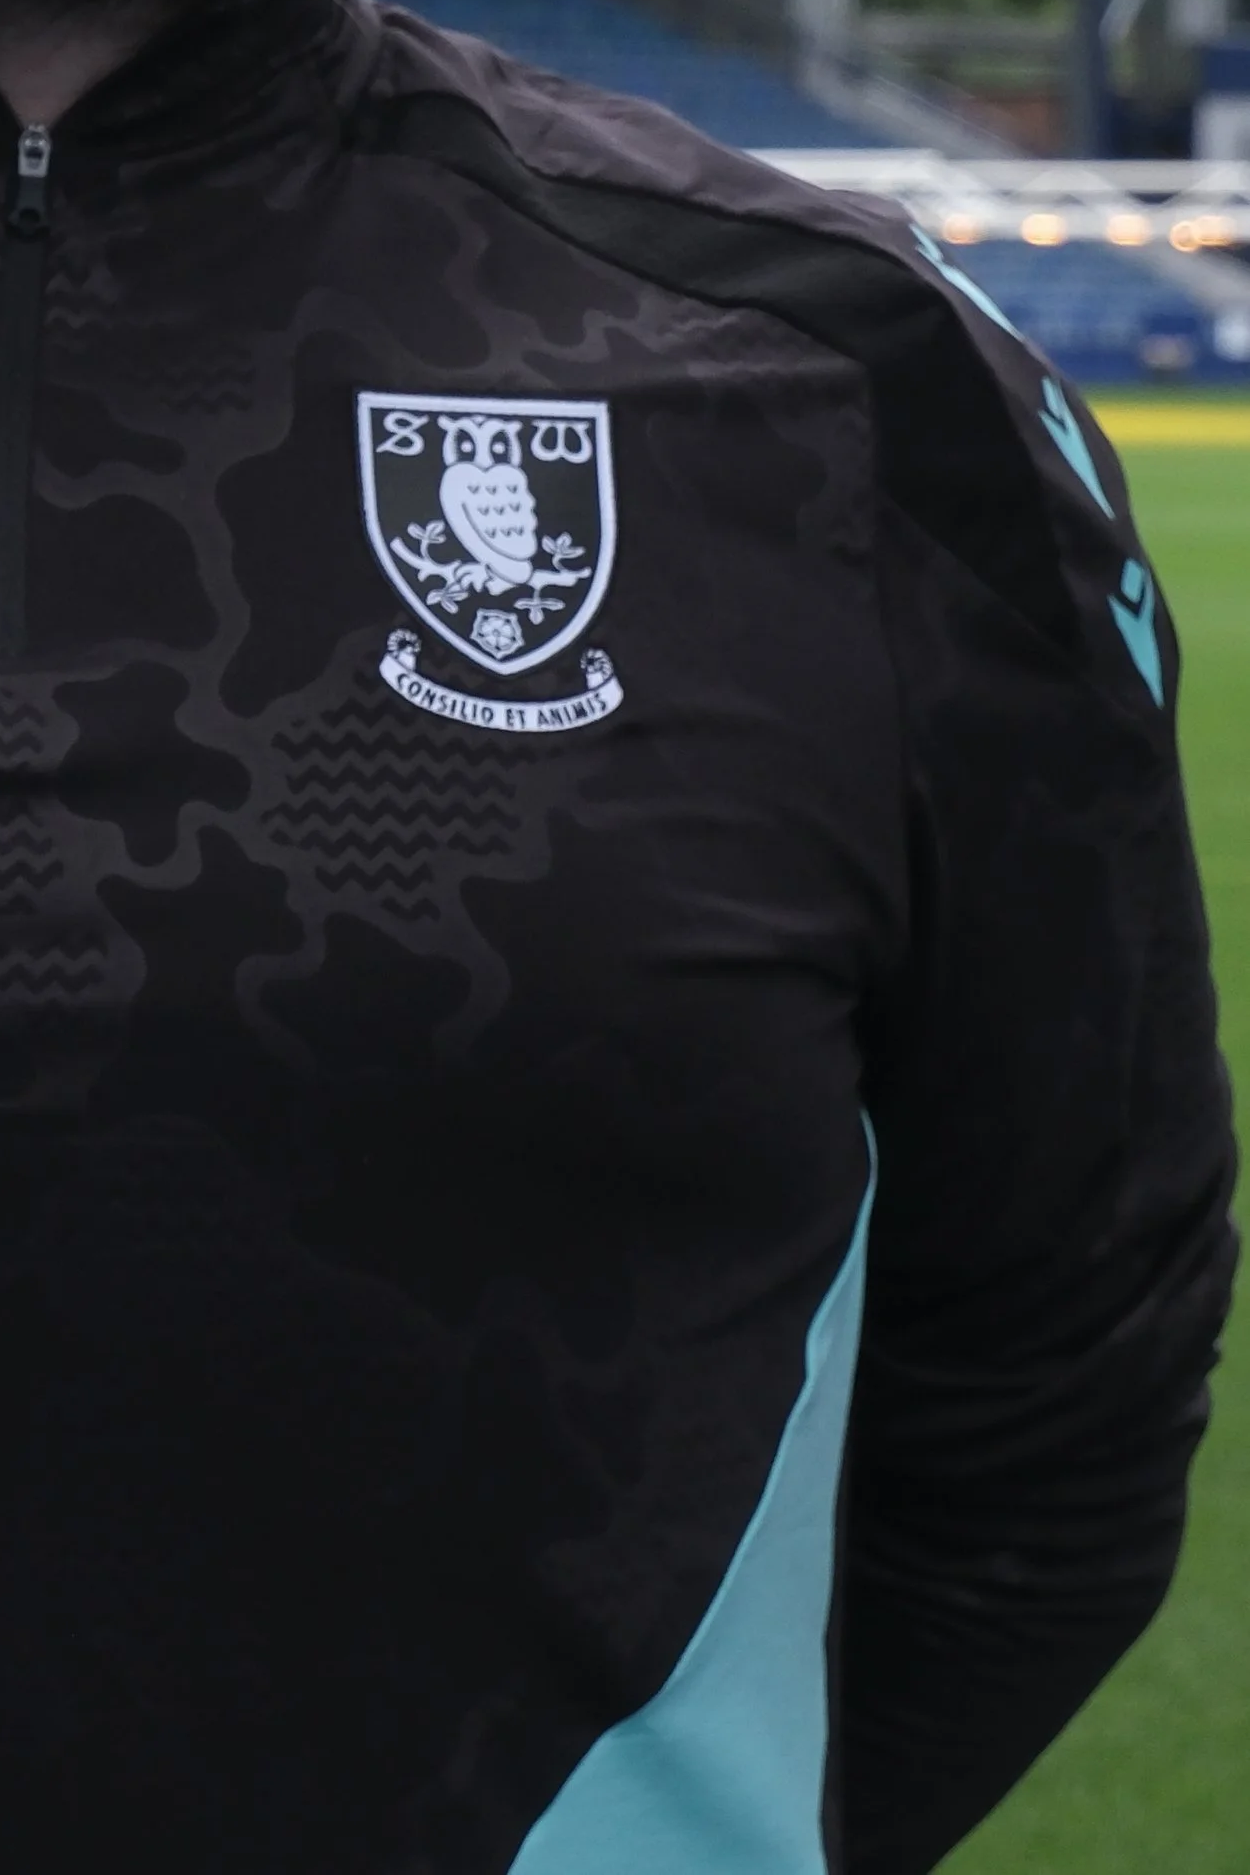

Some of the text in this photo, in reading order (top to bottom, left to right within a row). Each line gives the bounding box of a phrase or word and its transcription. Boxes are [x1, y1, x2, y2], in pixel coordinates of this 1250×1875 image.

[397, 673, 607, 729] CONSILIO ET ANIMIS
